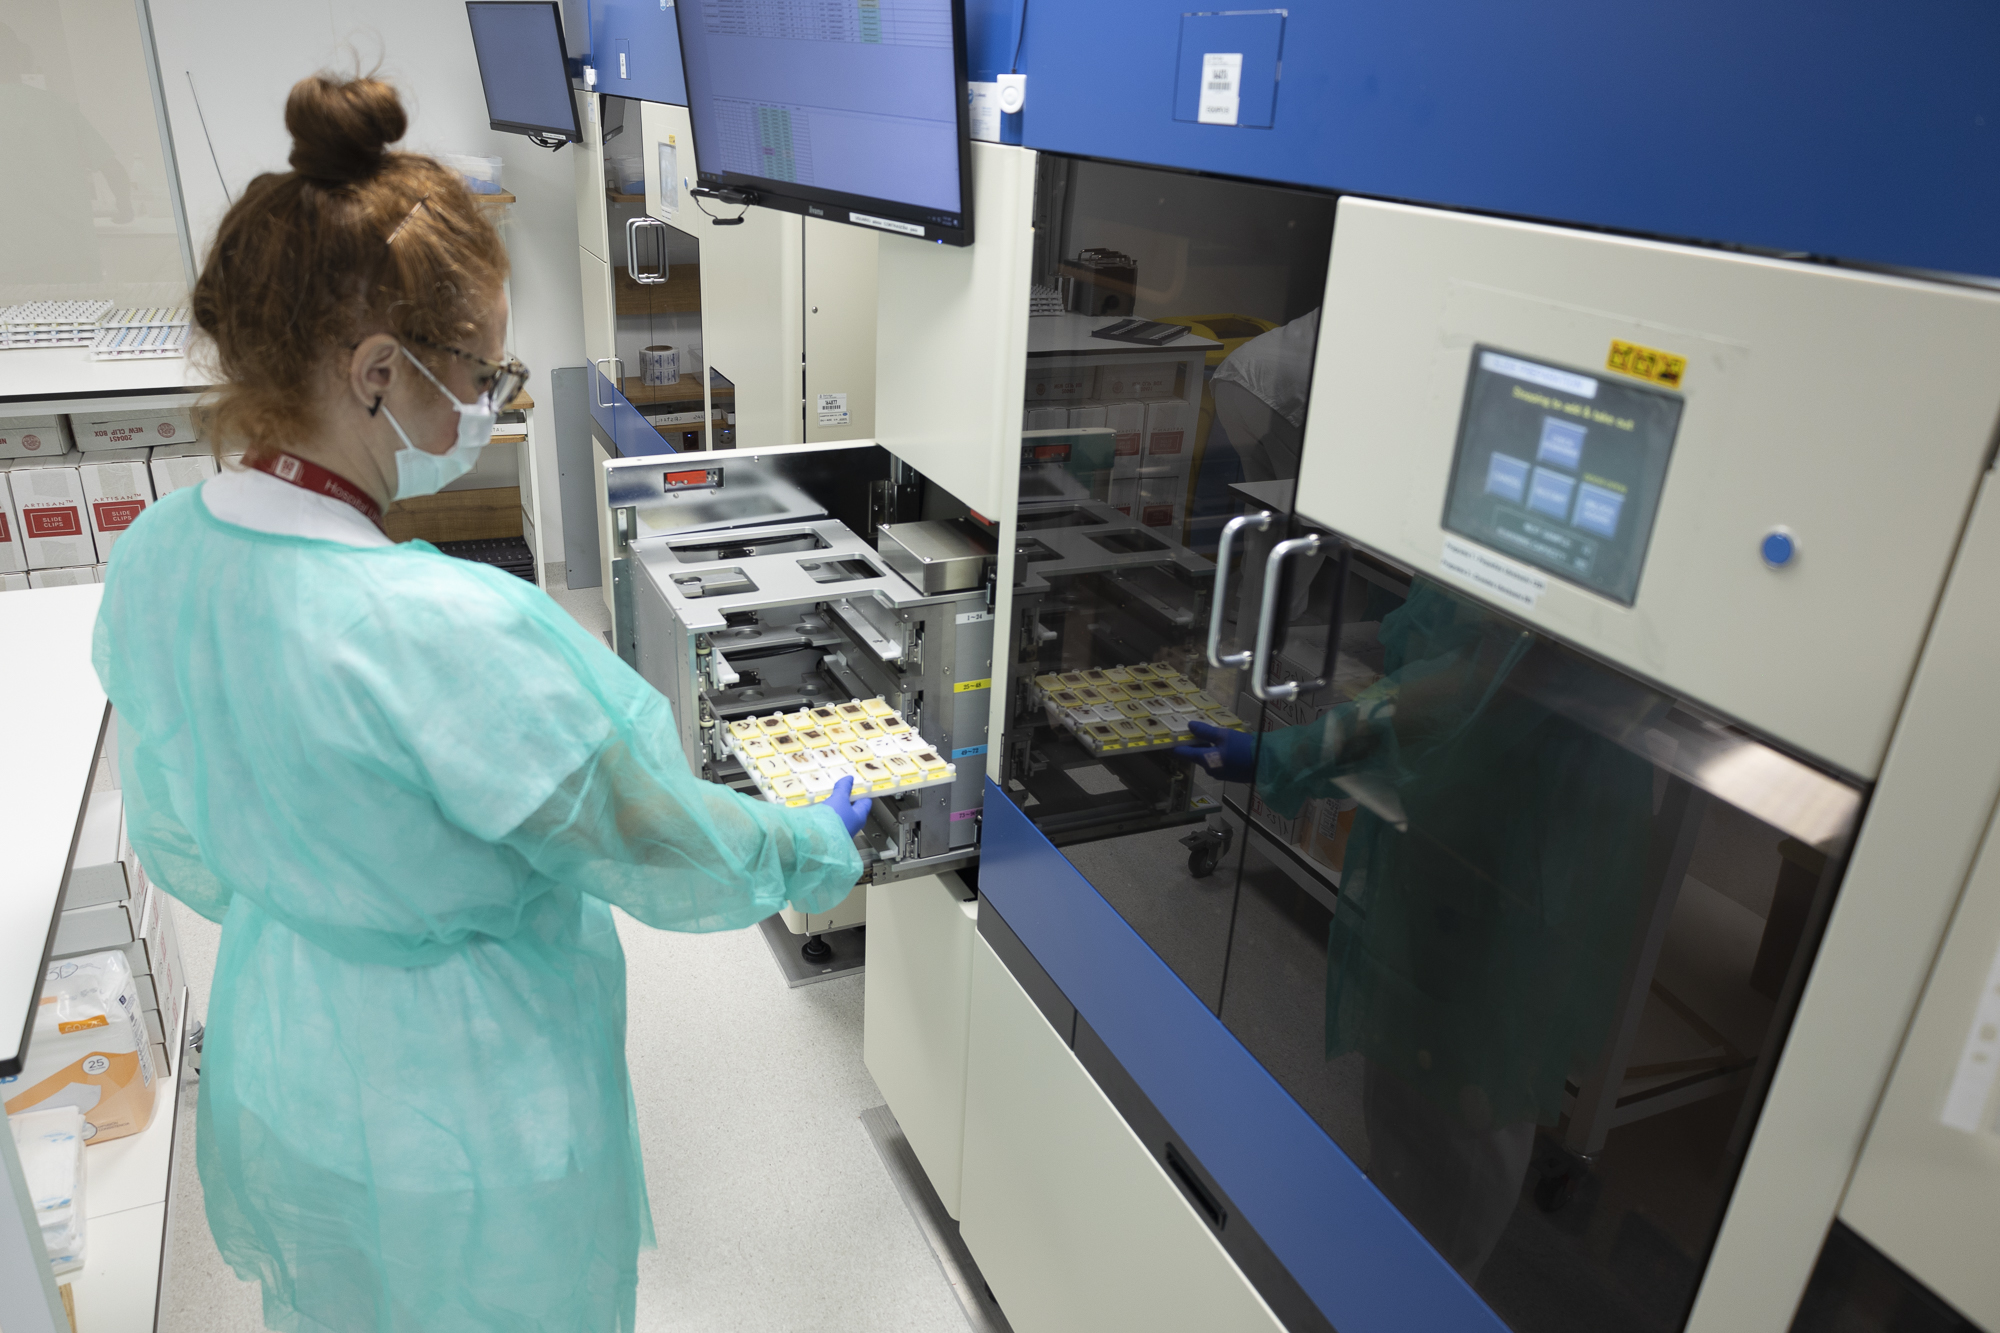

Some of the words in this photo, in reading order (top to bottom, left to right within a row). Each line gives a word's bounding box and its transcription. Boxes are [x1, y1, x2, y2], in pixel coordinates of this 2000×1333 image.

[109, 434, 133, 442] 200451
[324, 479, 370, 513] Hospital
[88, 1058, 105, 1069] 25
